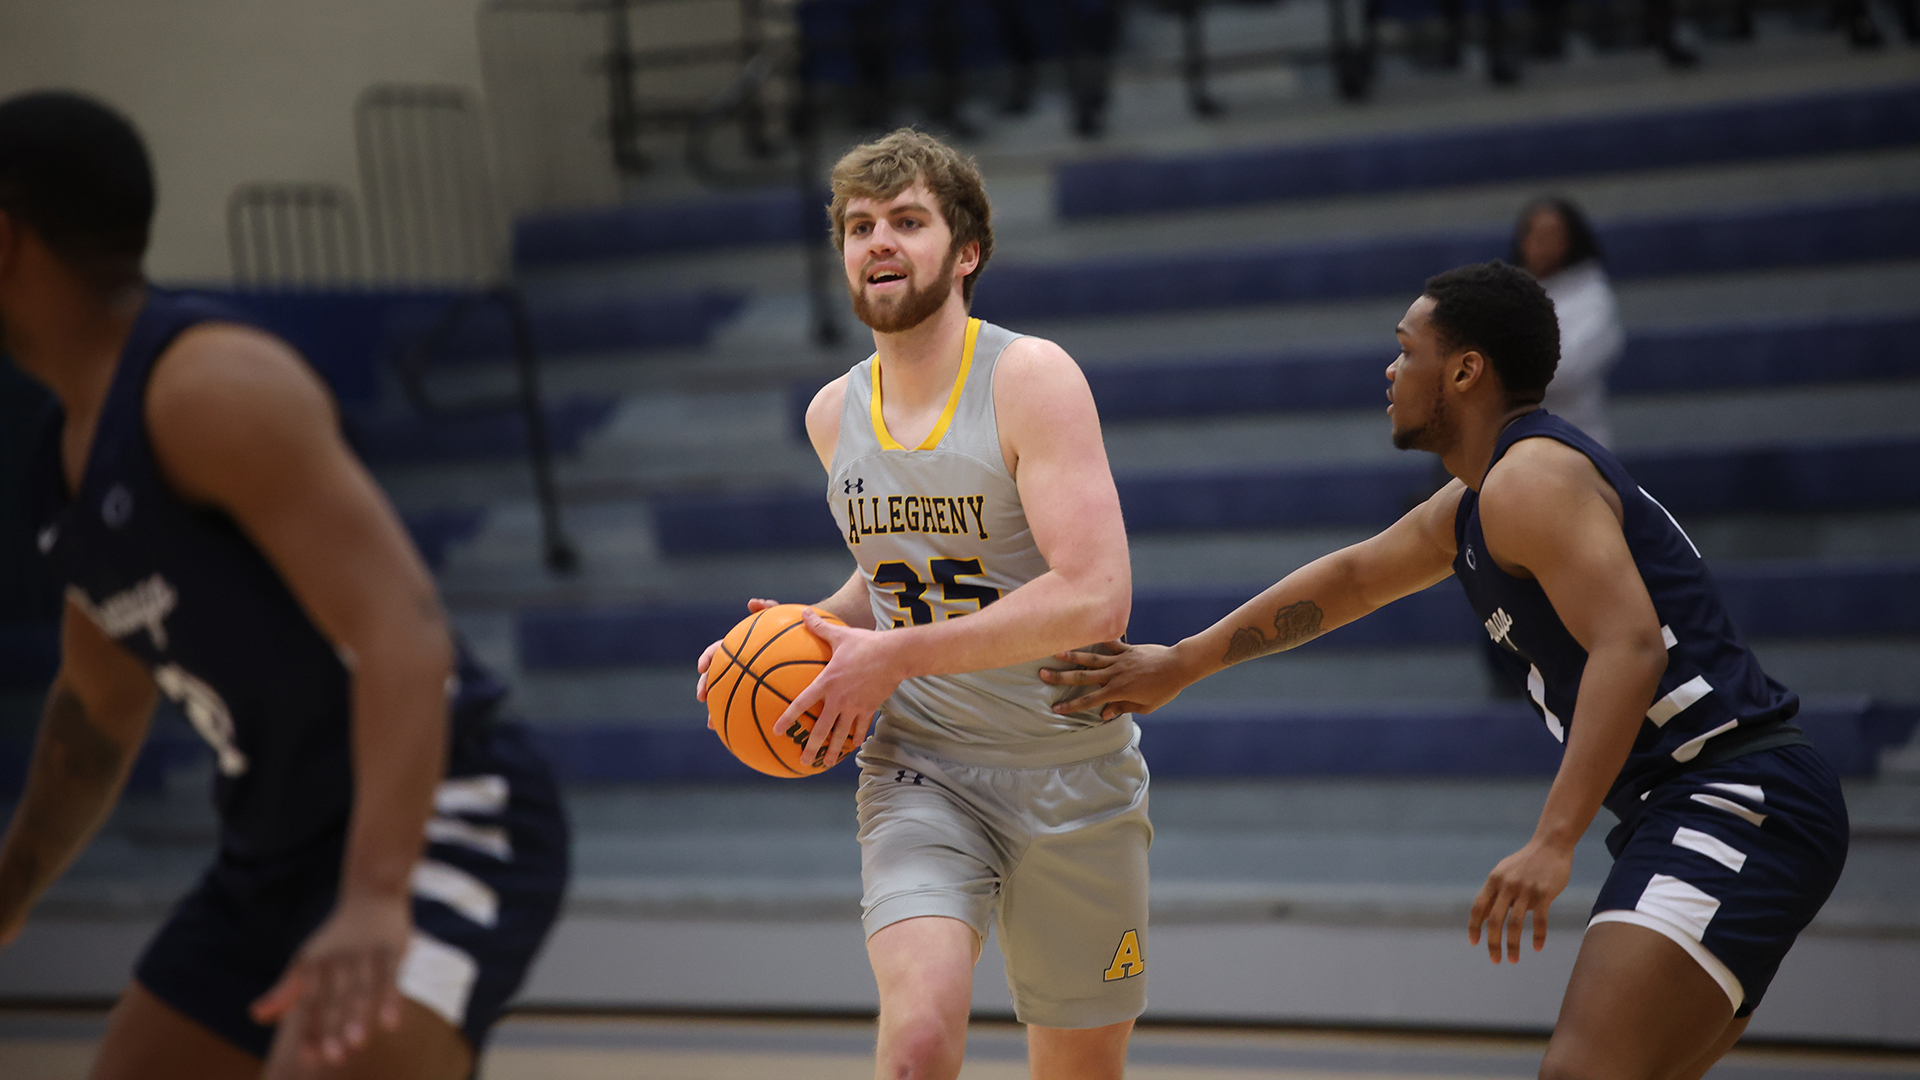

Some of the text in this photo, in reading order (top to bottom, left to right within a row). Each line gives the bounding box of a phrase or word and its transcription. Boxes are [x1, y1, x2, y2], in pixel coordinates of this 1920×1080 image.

[848, 494, 990, 544] ALLEGHENY
[872, 556, 1003, 628] 35
[1103, 928, 1145, 982] A
